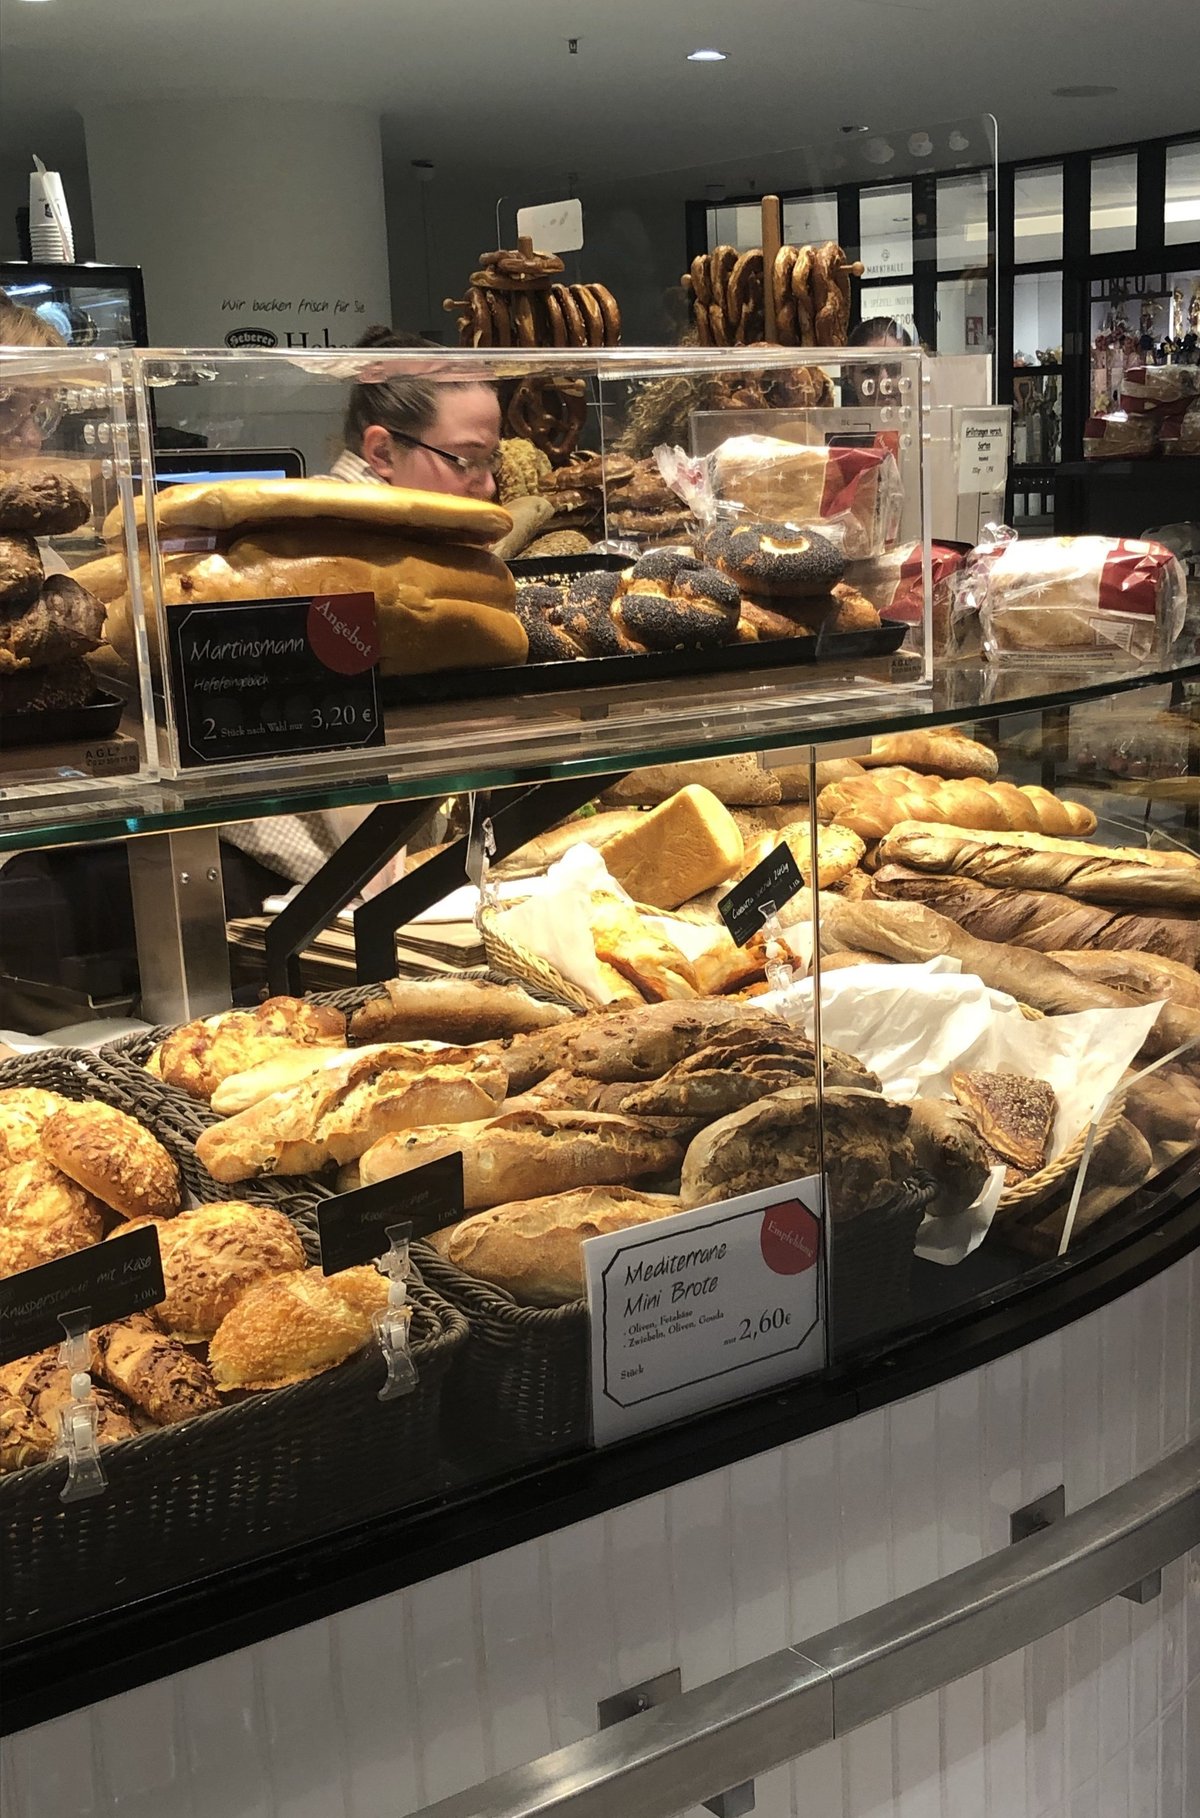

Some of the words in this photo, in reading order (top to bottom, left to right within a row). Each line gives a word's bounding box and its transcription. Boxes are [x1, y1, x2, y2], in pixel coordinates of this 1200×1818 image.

[221, 299, 245, 312] Wir
[252, 298, 292, 312] backen
[297, 299, 329, 315] frisch
[333, 299, 350, 315] für
[353, 301, 367, 314] Sie
[315, 601, 373, 657] Angebot
[190, 637, 306, 662] Martinsmann
[202, 717, 217, 741] 2
[220, 727, 245, 738] Stück
[246, 724, 266, 736] nach
[267, 721, 287, 733] Wahl
[289, 723, 304, 732] nur
[310, 705, 357, 731] 3,20
[361, 708, 372, 723] €
[623, 1291, 664, 1319] Mini
[671, 1276, 719, 1304] Brote
[698, 1309, 725, 1325] Gouda
[620, 1364, 645, 1380] Stück
